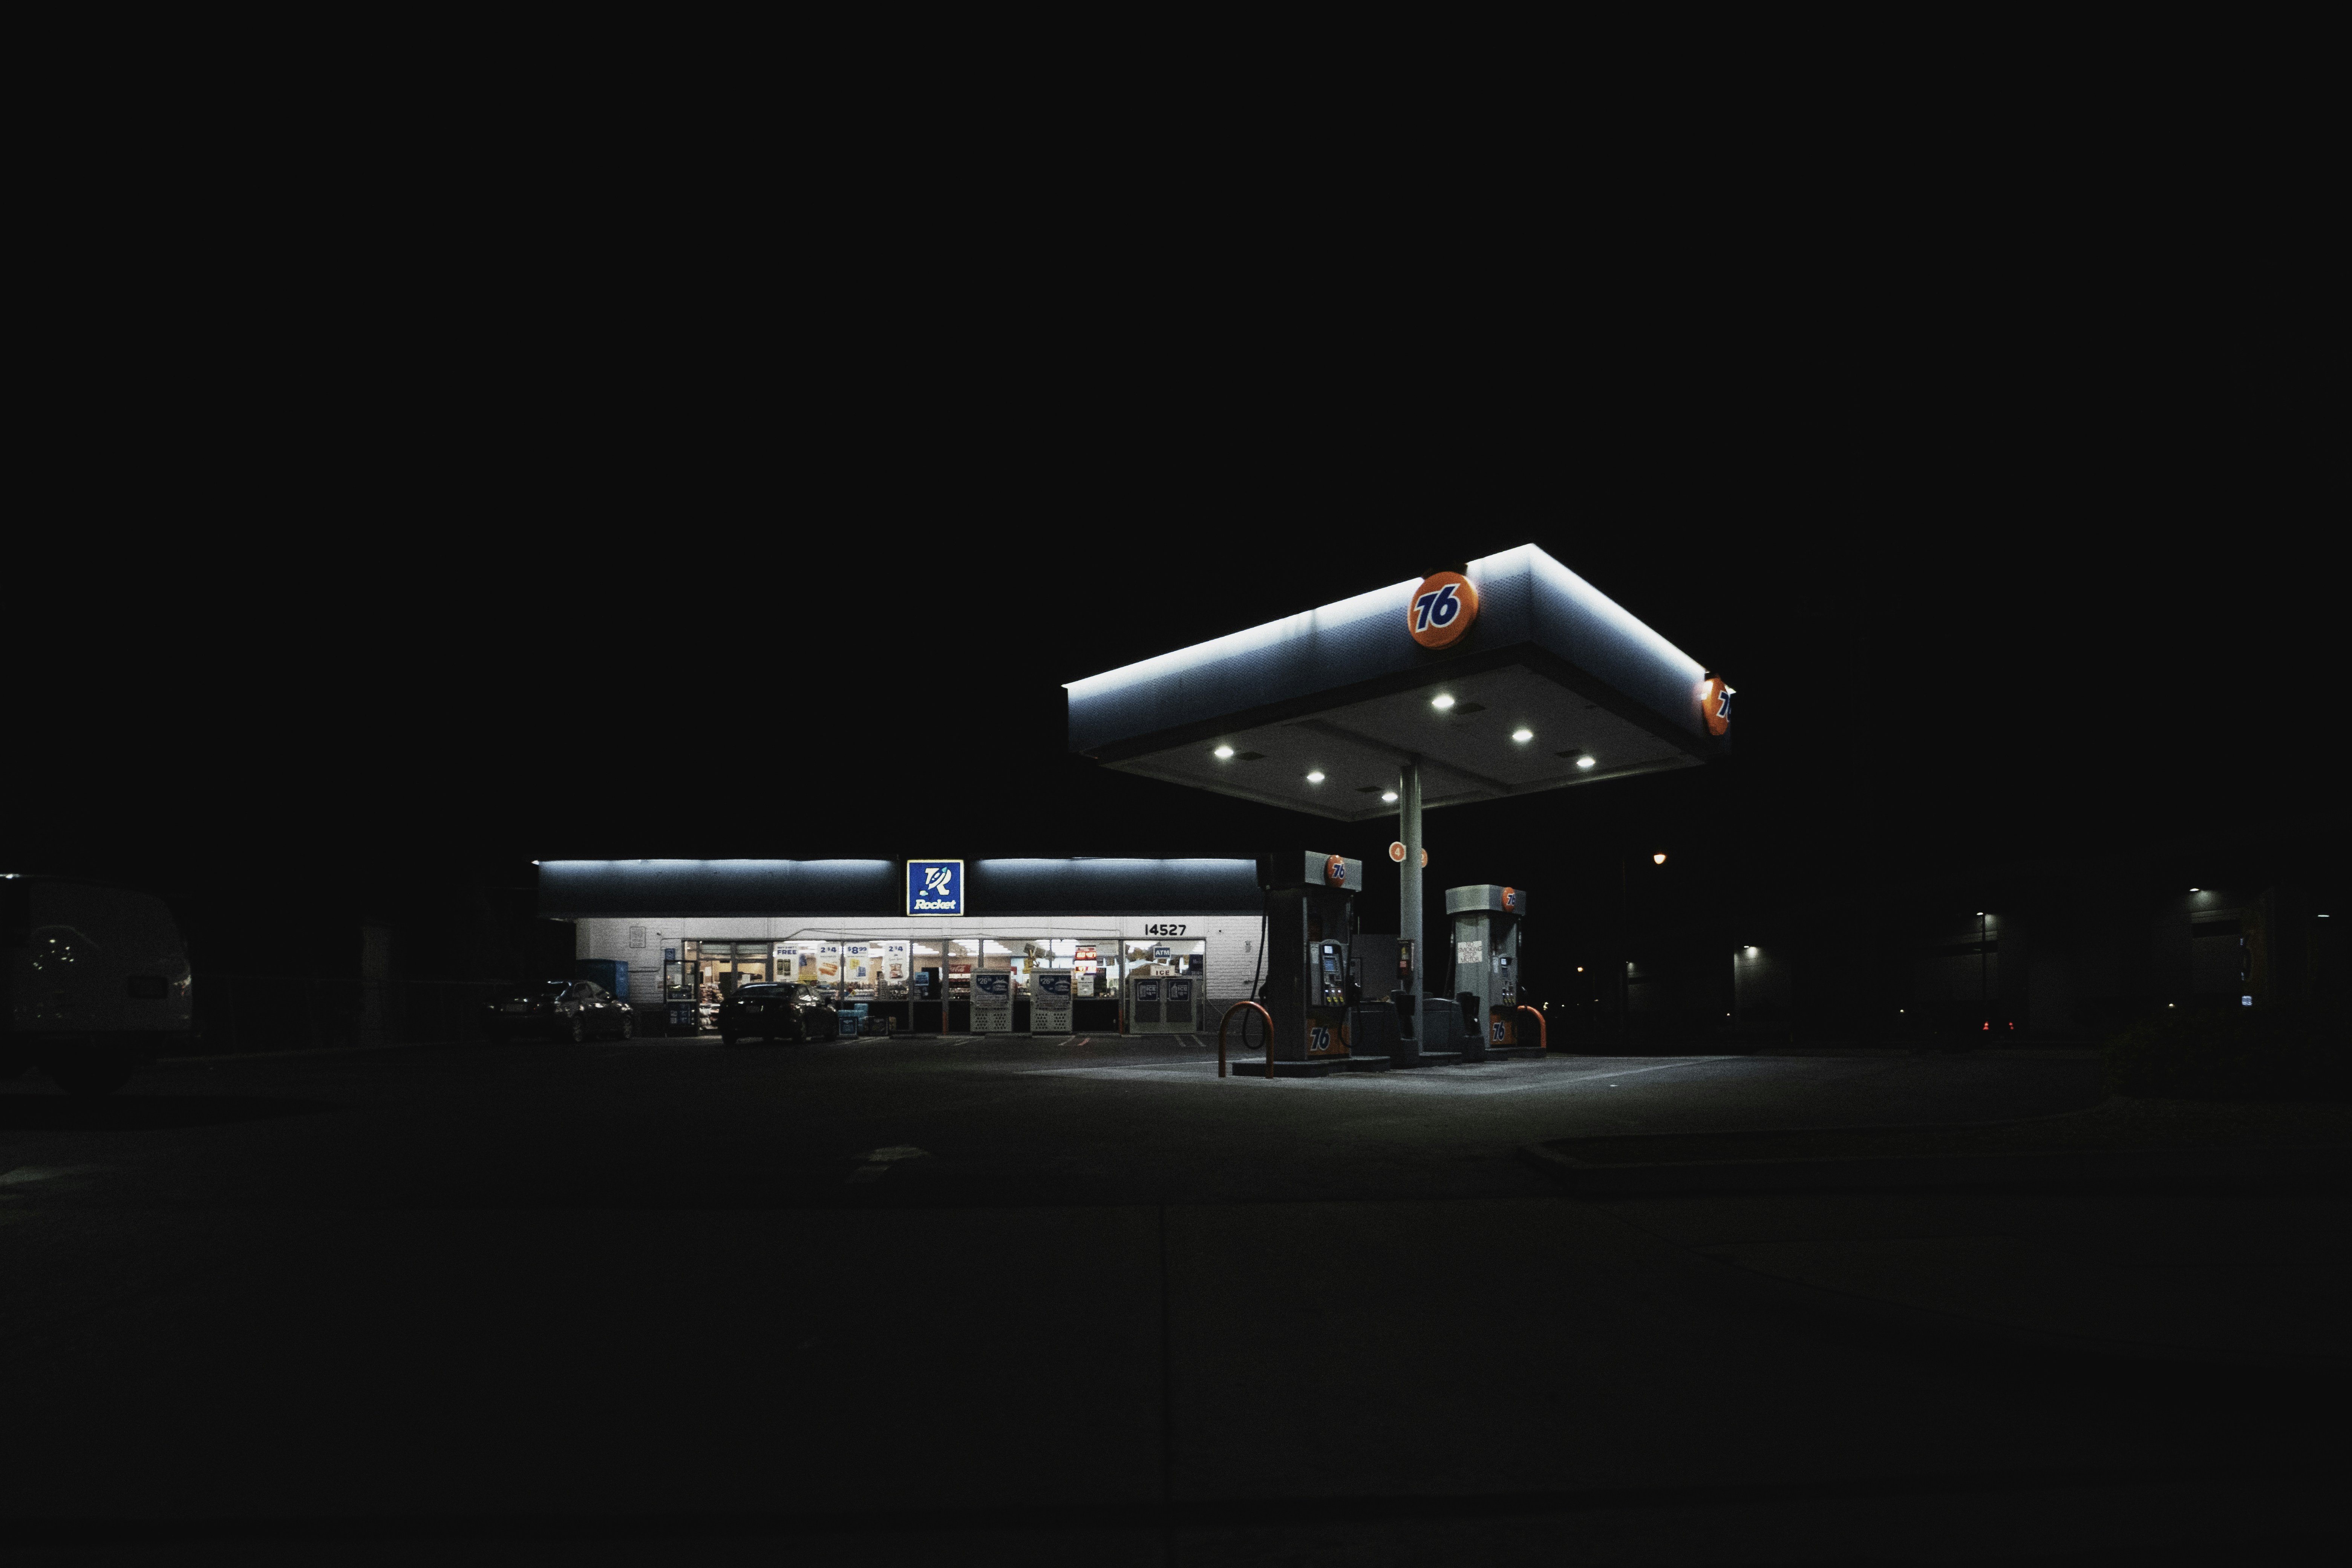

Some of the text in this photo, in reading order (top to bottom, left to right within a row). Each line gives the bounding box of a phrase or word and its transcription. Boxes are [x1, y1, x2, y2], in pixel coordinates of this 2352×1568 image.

[1413, 583, 1461, 633] 76
[1395, 847, 1401, 856] 4
[1332, 862, 1344, 880] 76
[914, 899, 956, 910] Rocket
[1145, 924, 1186, 936] 14527
[1310, 1025, 1330, 1051] 76
[1493, 1020, 1505, 1041] 76
